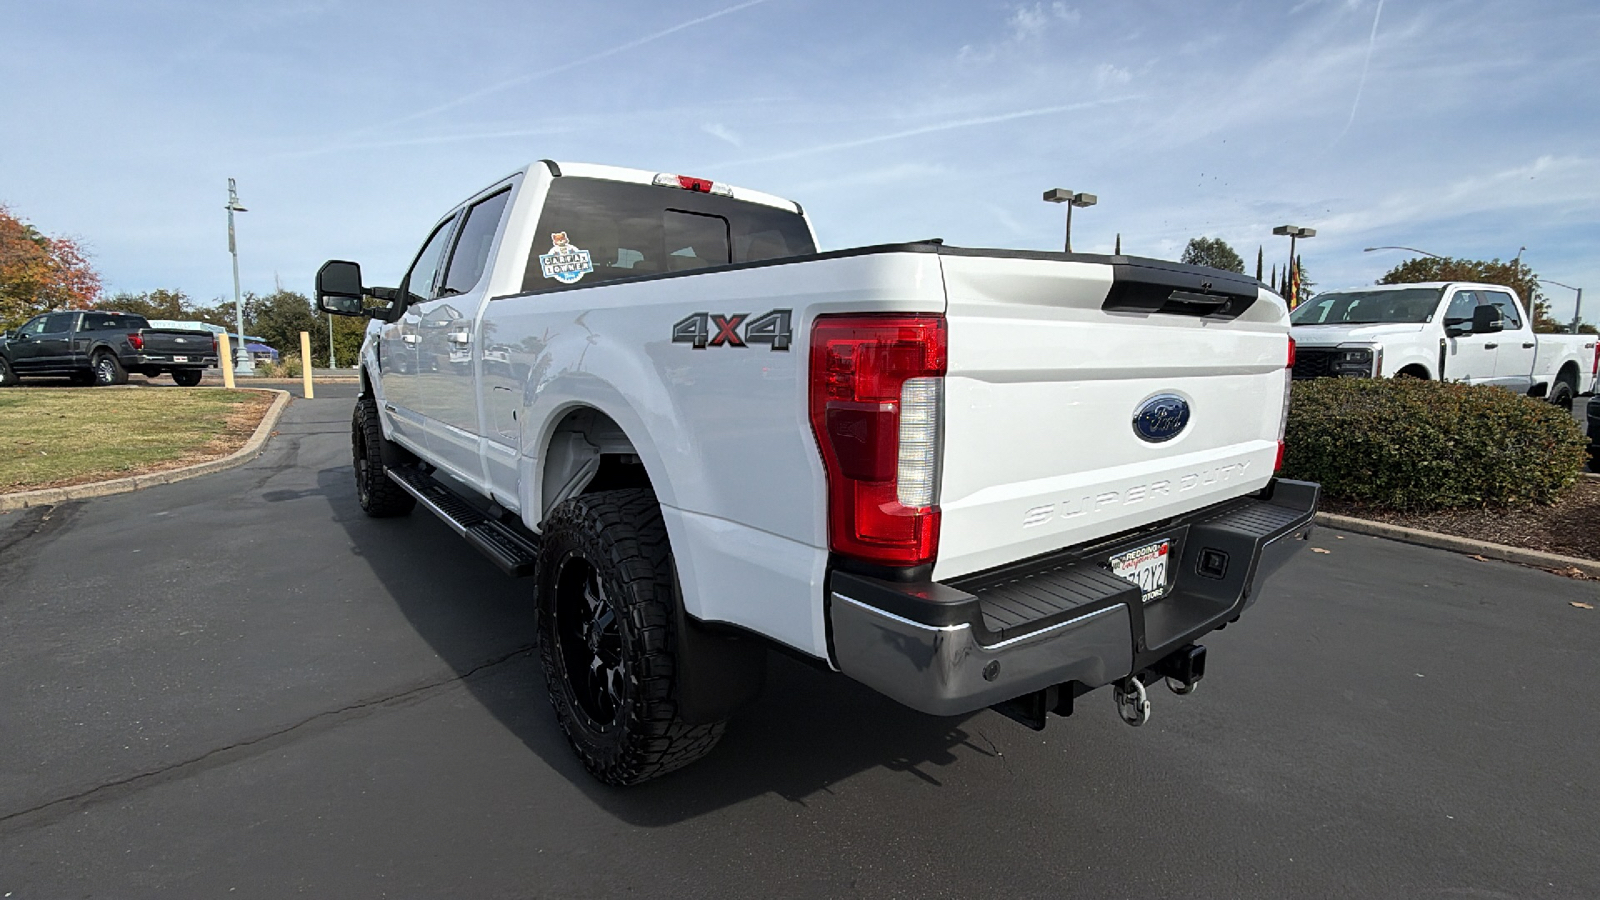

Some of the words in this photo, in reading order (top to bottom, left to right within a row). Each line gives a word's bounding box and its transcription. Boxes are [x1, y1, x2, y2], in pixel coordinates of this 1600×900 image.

[545, 254, 588, 264] CARFAX
[1150, 404, 1185, 432] Ford
[1022, 479, 1171, 529] SUPER
[1179, 460, 1251, 493] DUTY
[1127, 544, 1158, 561] REDDING
[1125, 562, 1165, 592] 712Y2
[1141, 587, 1164, 602] OTORS
